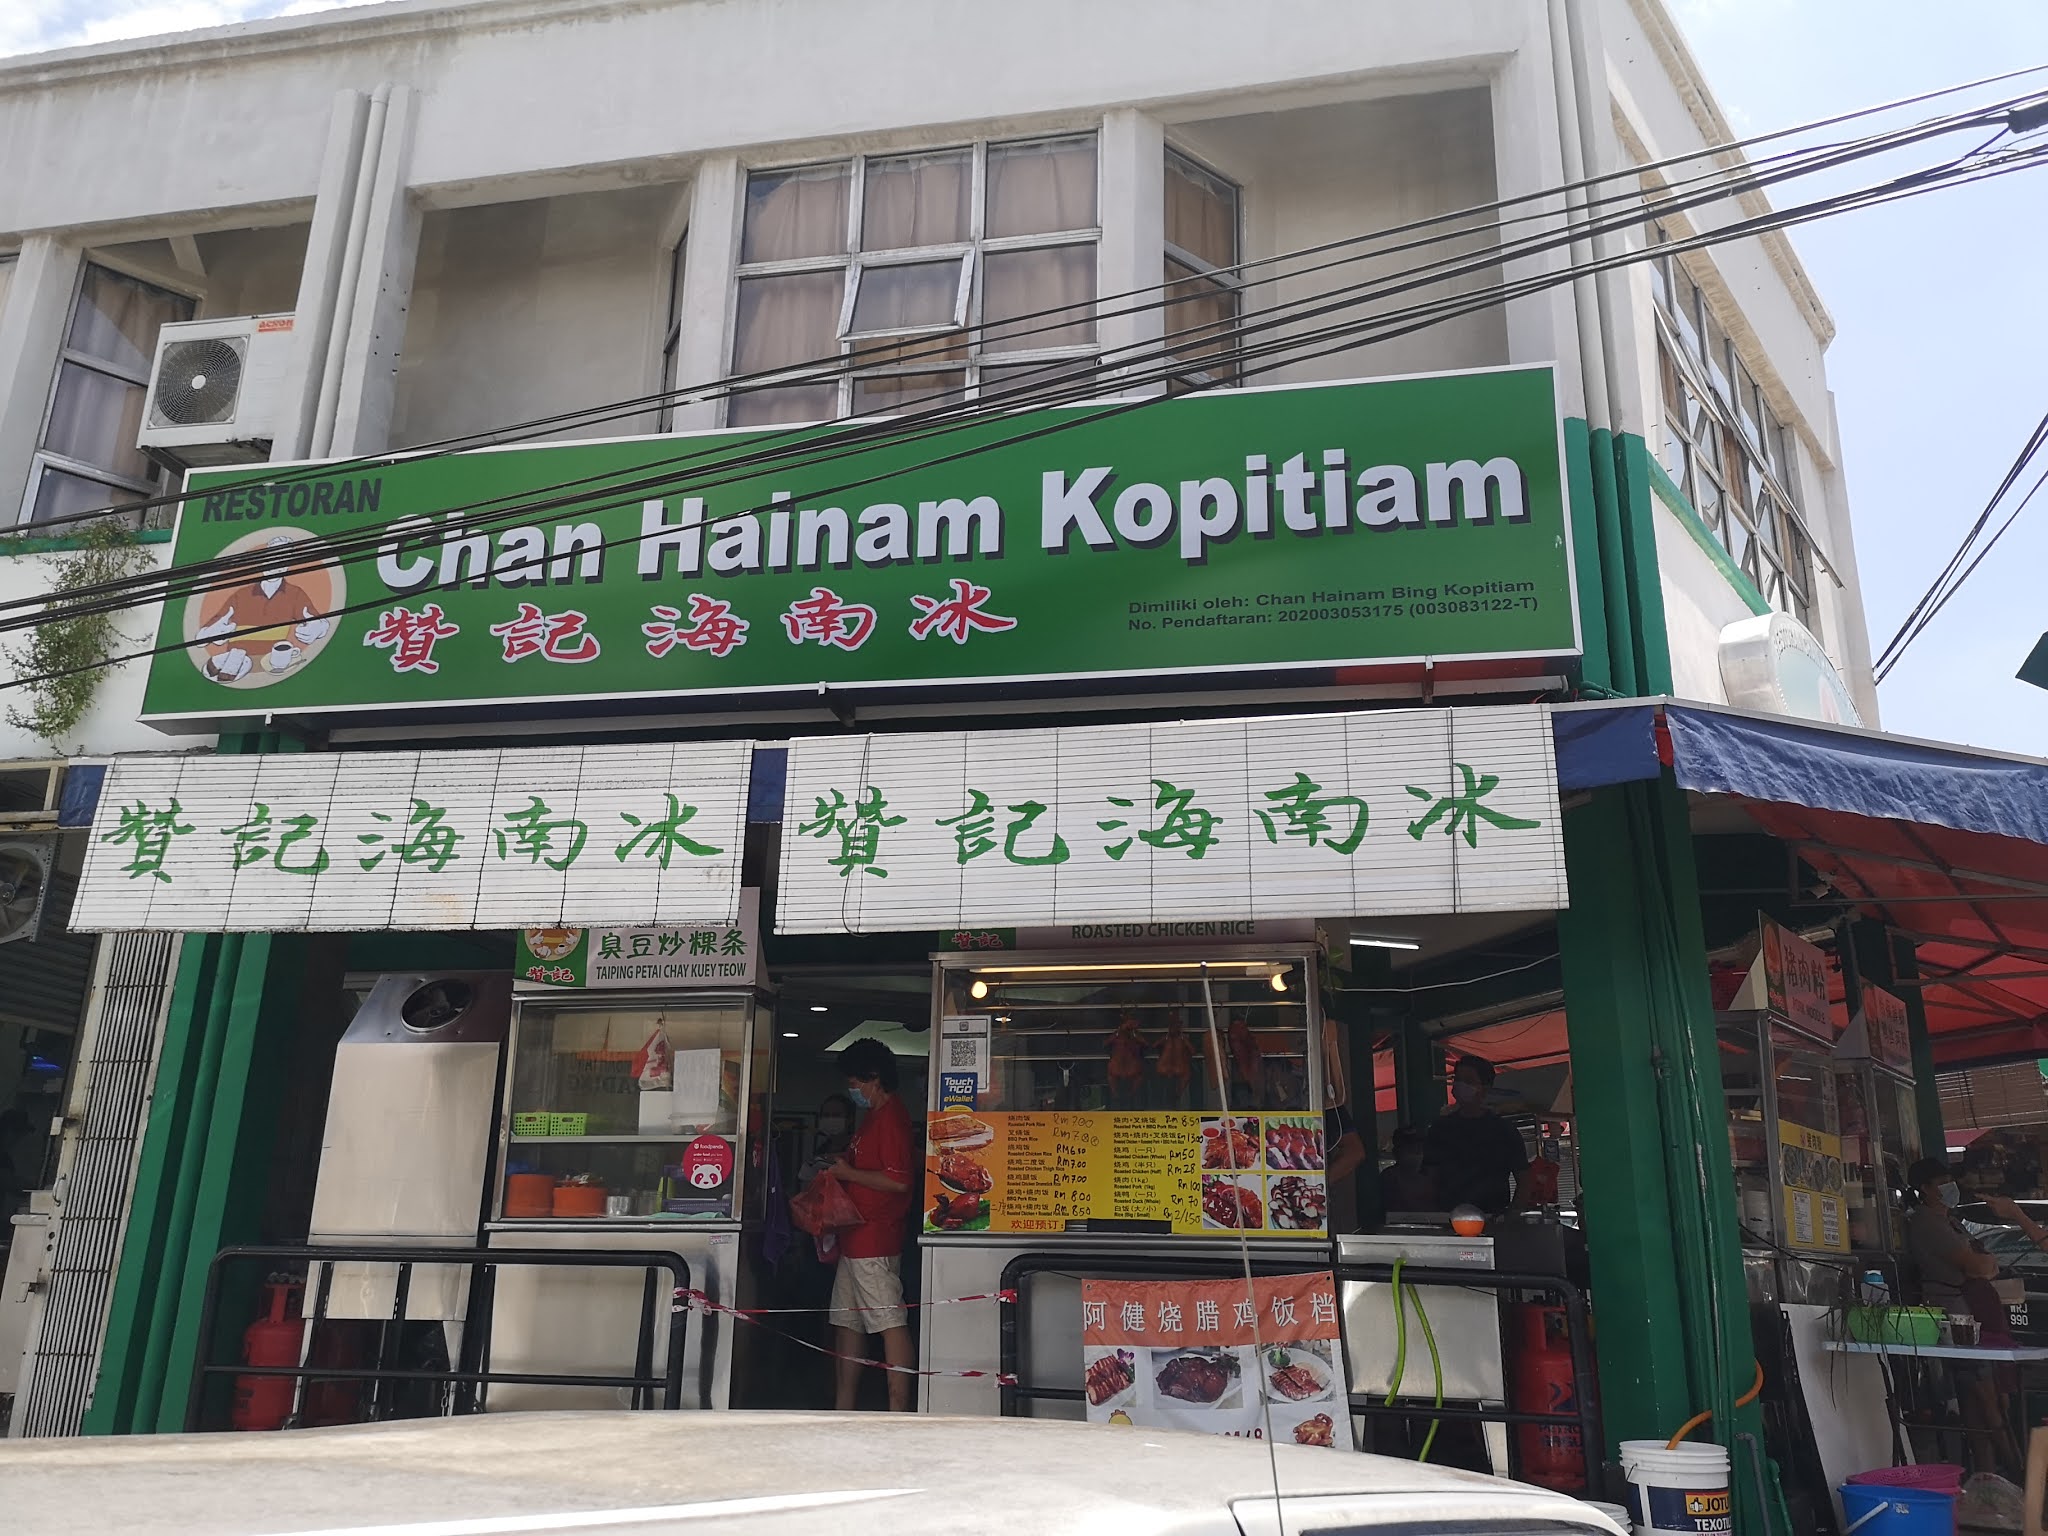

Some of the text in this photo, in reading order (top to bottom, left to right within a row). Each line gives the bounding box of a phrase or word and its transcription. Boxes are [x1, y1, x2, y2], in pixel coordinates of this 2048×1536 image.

[203, 478, 383, 523] RESTORAN
[377, 449, 1526, 590] Chan Hainam Kopitiam
[1128, 580, 1535, 614] Dimiliki oleh: Chan Hainam Bing Kopitiam
[1128, 597, 1538, 631] No. Pendaftaran: 202003053175 (003083122-T)
[597, 929, 748, 959] 臭豆炒粿条
[1071, 920, 1255, 940] ROASTED CHICKEN RICE
[596, 962, 747, 980] TAIPING PETAI CHAY KUEY TEOW
[944, 1077, 973, 1086] Touch
[943, 1095, 974, 1103] eWallet
[1082, 1292, 1336, 1333] 阿健烧腊鸡饭档
[2010, 1314, 2029, 1326] 990
